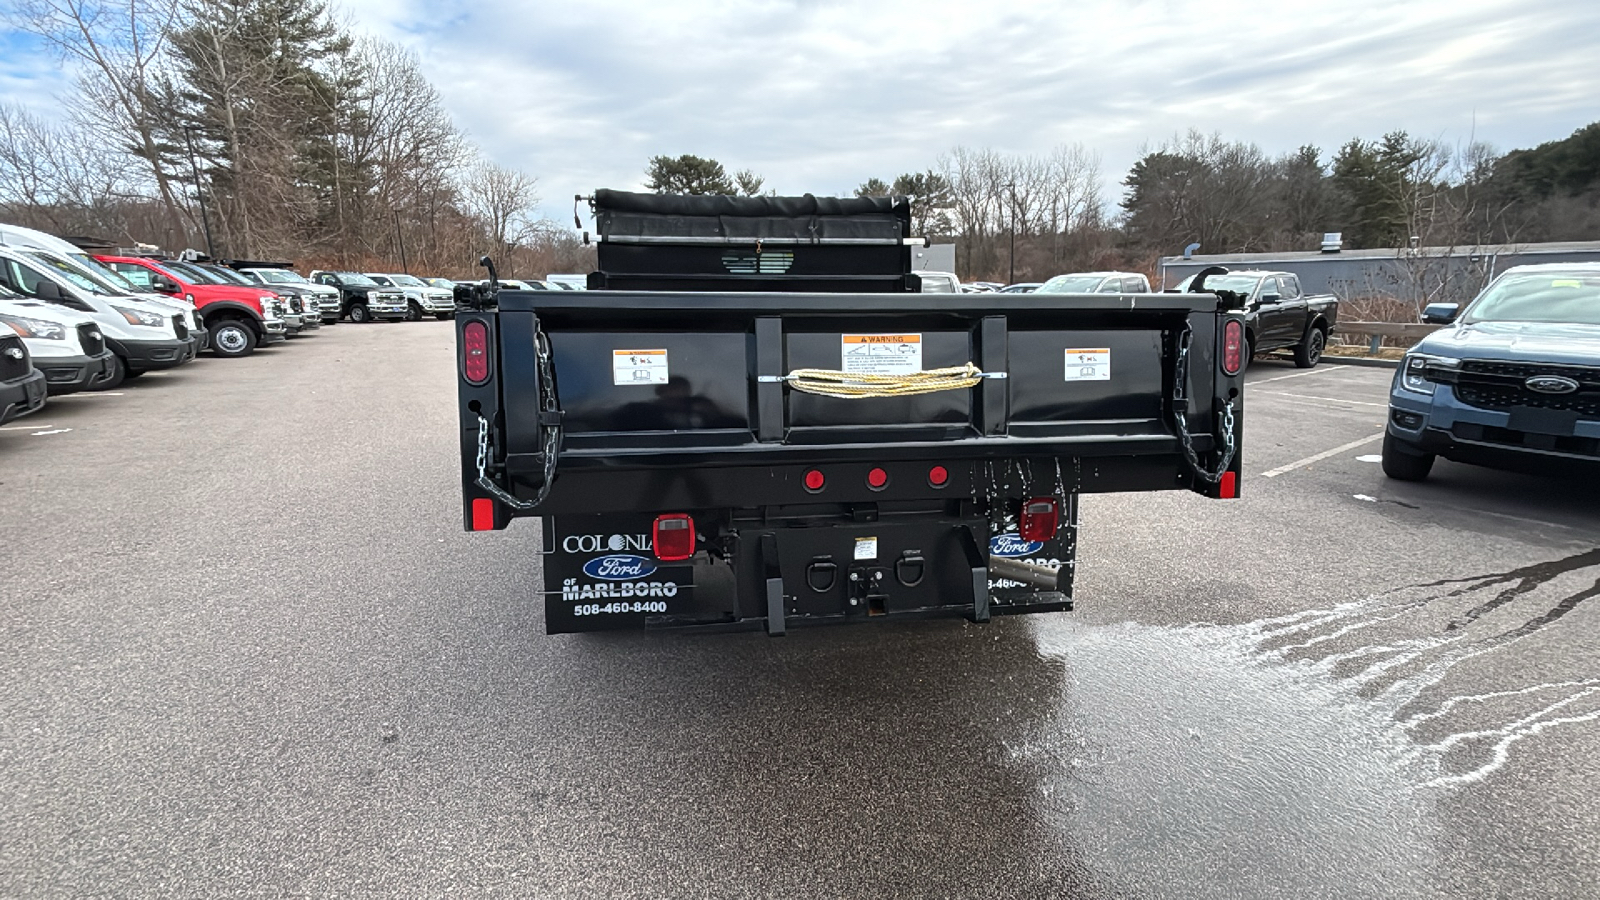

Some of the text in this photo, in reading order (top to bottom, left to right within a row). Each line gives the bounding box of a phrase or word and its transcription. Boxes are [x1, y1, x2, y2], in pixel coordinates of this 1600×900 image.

[598, 557, 642, 576] Ford
[563, 578, 577, 586] OF
[563, 582, 678, 602] MARLBORO
[574, 602, 667, 616] 508-460-8400
